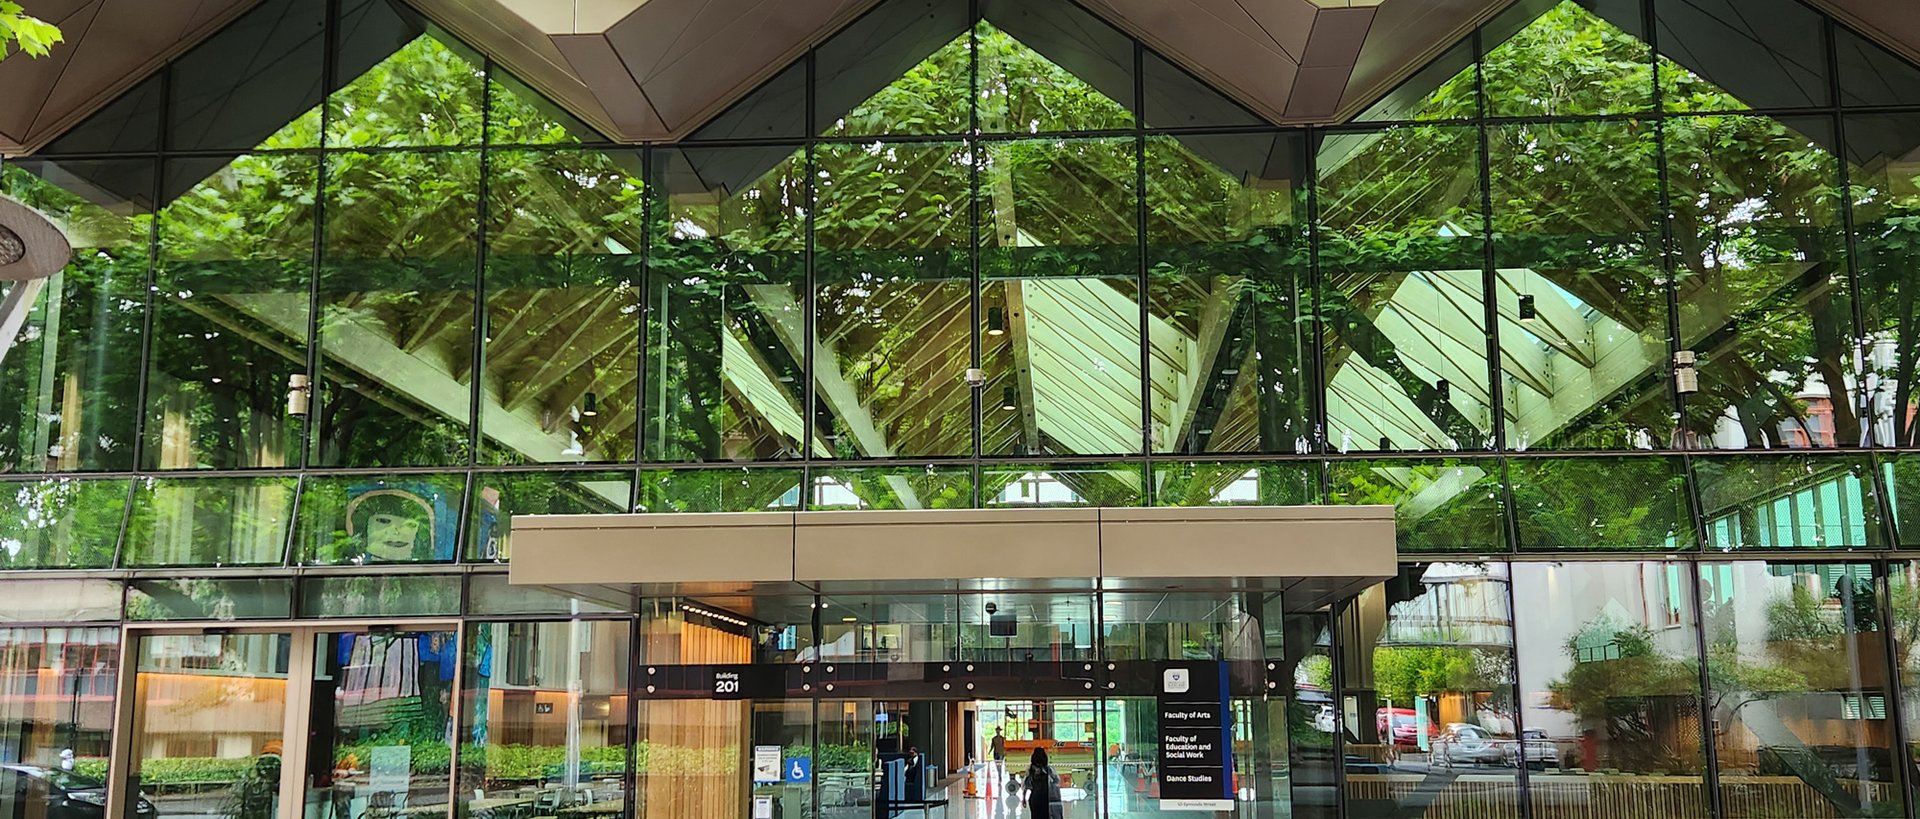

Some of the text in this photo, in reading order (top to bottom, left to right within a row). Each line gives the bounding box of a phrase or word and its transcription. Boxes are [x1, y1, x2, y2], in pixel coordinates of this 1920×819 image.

[715, 672, 739, 681] Building
[715, 681, 739, 693] 201
[1164, 711, 1188, 720] Faculty
[1189, 711, 1197, 719] of
[1165, 735, 1189, 743] Faculty
[1187, 774, 1212, 782] Studies
